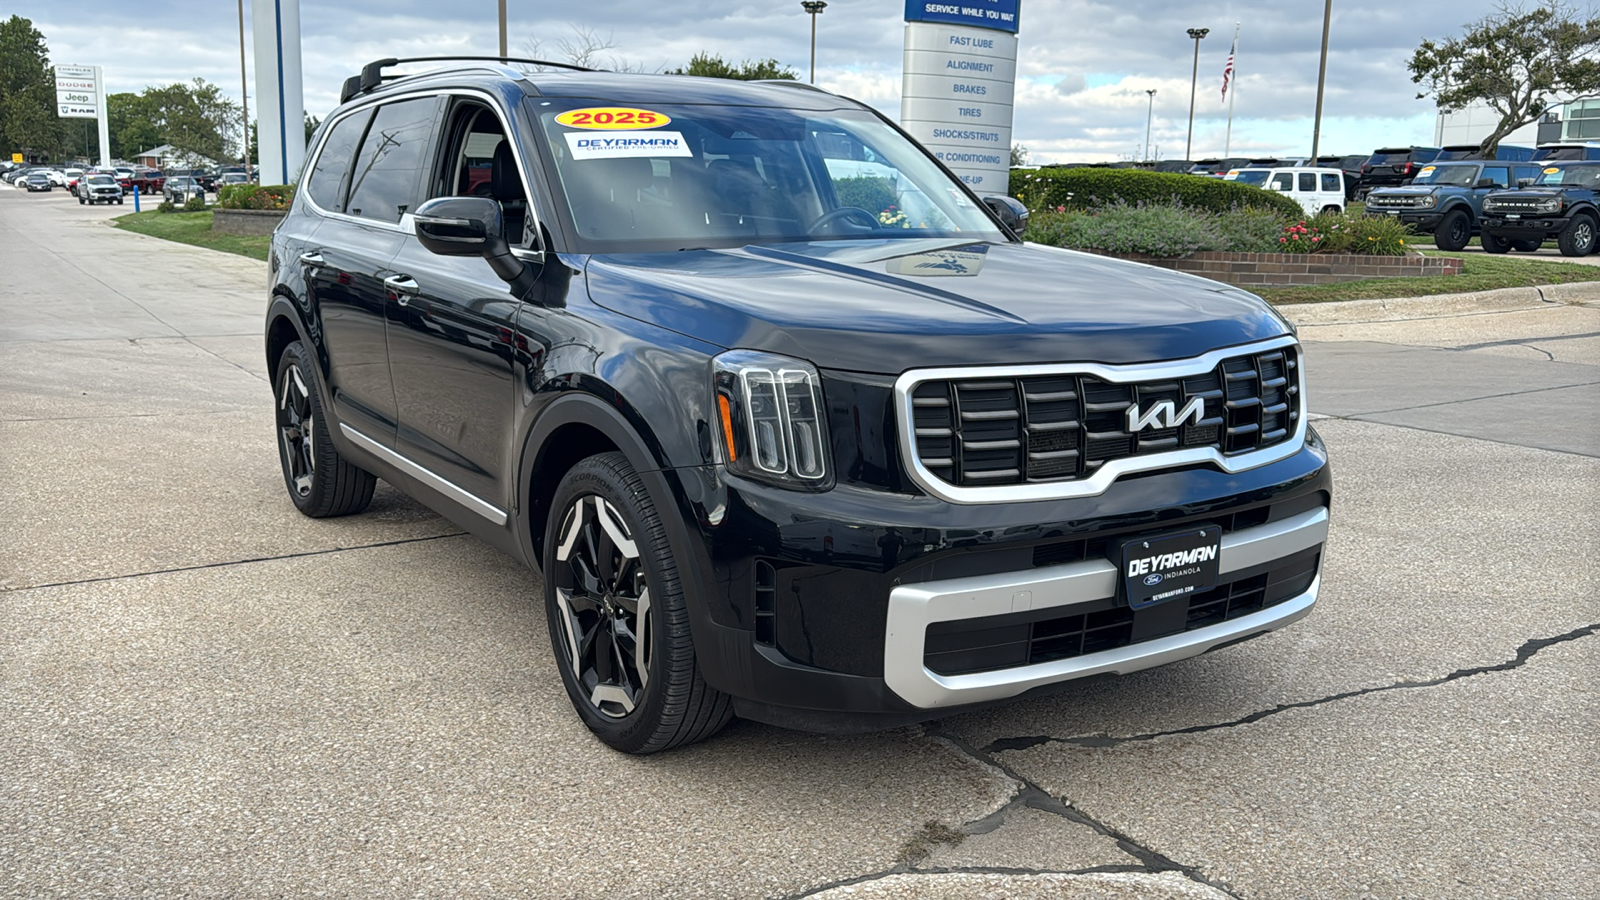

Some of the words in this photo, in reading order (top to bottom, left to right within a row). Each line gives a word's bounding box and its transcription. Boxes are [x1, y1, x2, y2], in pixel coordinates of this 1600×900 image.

[925, 3, 959, 15] SERVICE
[961, 7, 984, 18] WHILE
[985, 10, 999, 20] YOU
[1000, 12, 1015, 22] WAIT
[950, 35, 971, 46] FAST
[973, 38, 994, 49] LUBE
[947, 60, 993, 73] ALIGNMENT
[953, 84, 987, 95] BRAKES
[65, 93, 89, 103] Jeep
[571, 112, 658, 125] 2025
[958, 107, 982, 118] TIRES
[933, 128, 999, 142] SHOCKS/STRUTS
[577, 138, 678, 148] DEYARMAN
[946, 152, 1000, 164] CONDITIONING
[960, 175, 983, 184] NE-UP
[1125, 396, 1204, 433] KIA
[569, 473, 614, 493] SCORPION
[1128, 544, 1218, 578] DEYARMAN
[1164, 566, 1201, 580] INDIANOLA
